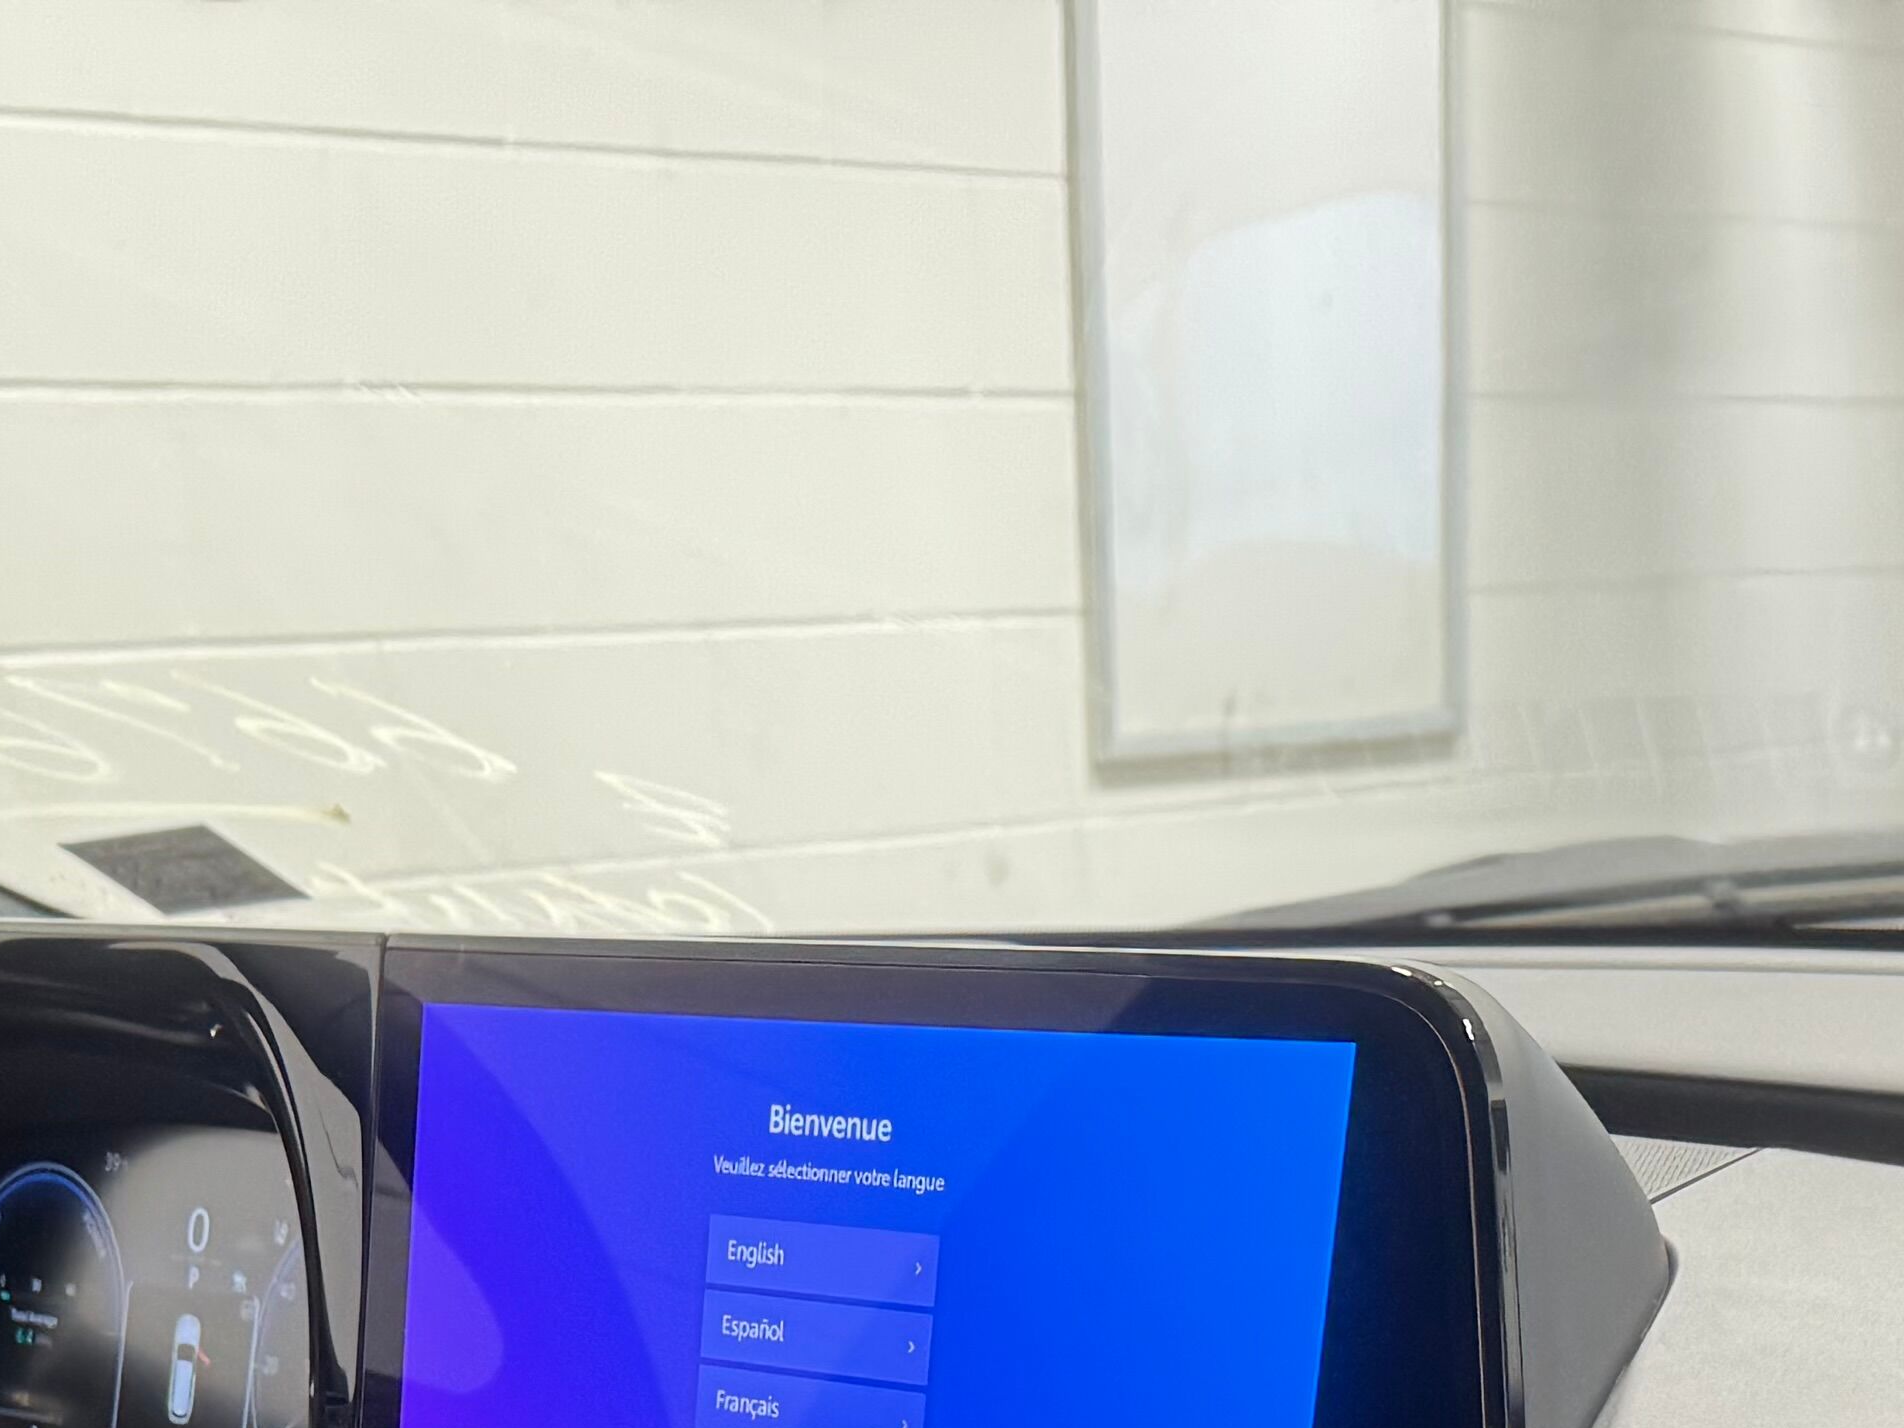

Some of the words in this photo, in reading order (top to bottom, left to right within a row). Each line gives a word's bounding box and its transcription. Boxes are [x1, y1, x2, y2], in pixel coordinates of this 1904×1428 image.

[769, 1104, 892, 1142] Bienvenue
[713, 1155, 765, 1177] Veuillez
[768, 1160, 852, 1184] sélectionner
[854, 1170, 891, 1187] votre
[893, 1169, 945, 1195] langue
[187, 1206, 210, 1253] 0
[728, 1240, 784, 1268] English
[722, 1314, 784, 1342] Español
[716, 1389, 779, 1420] Français
